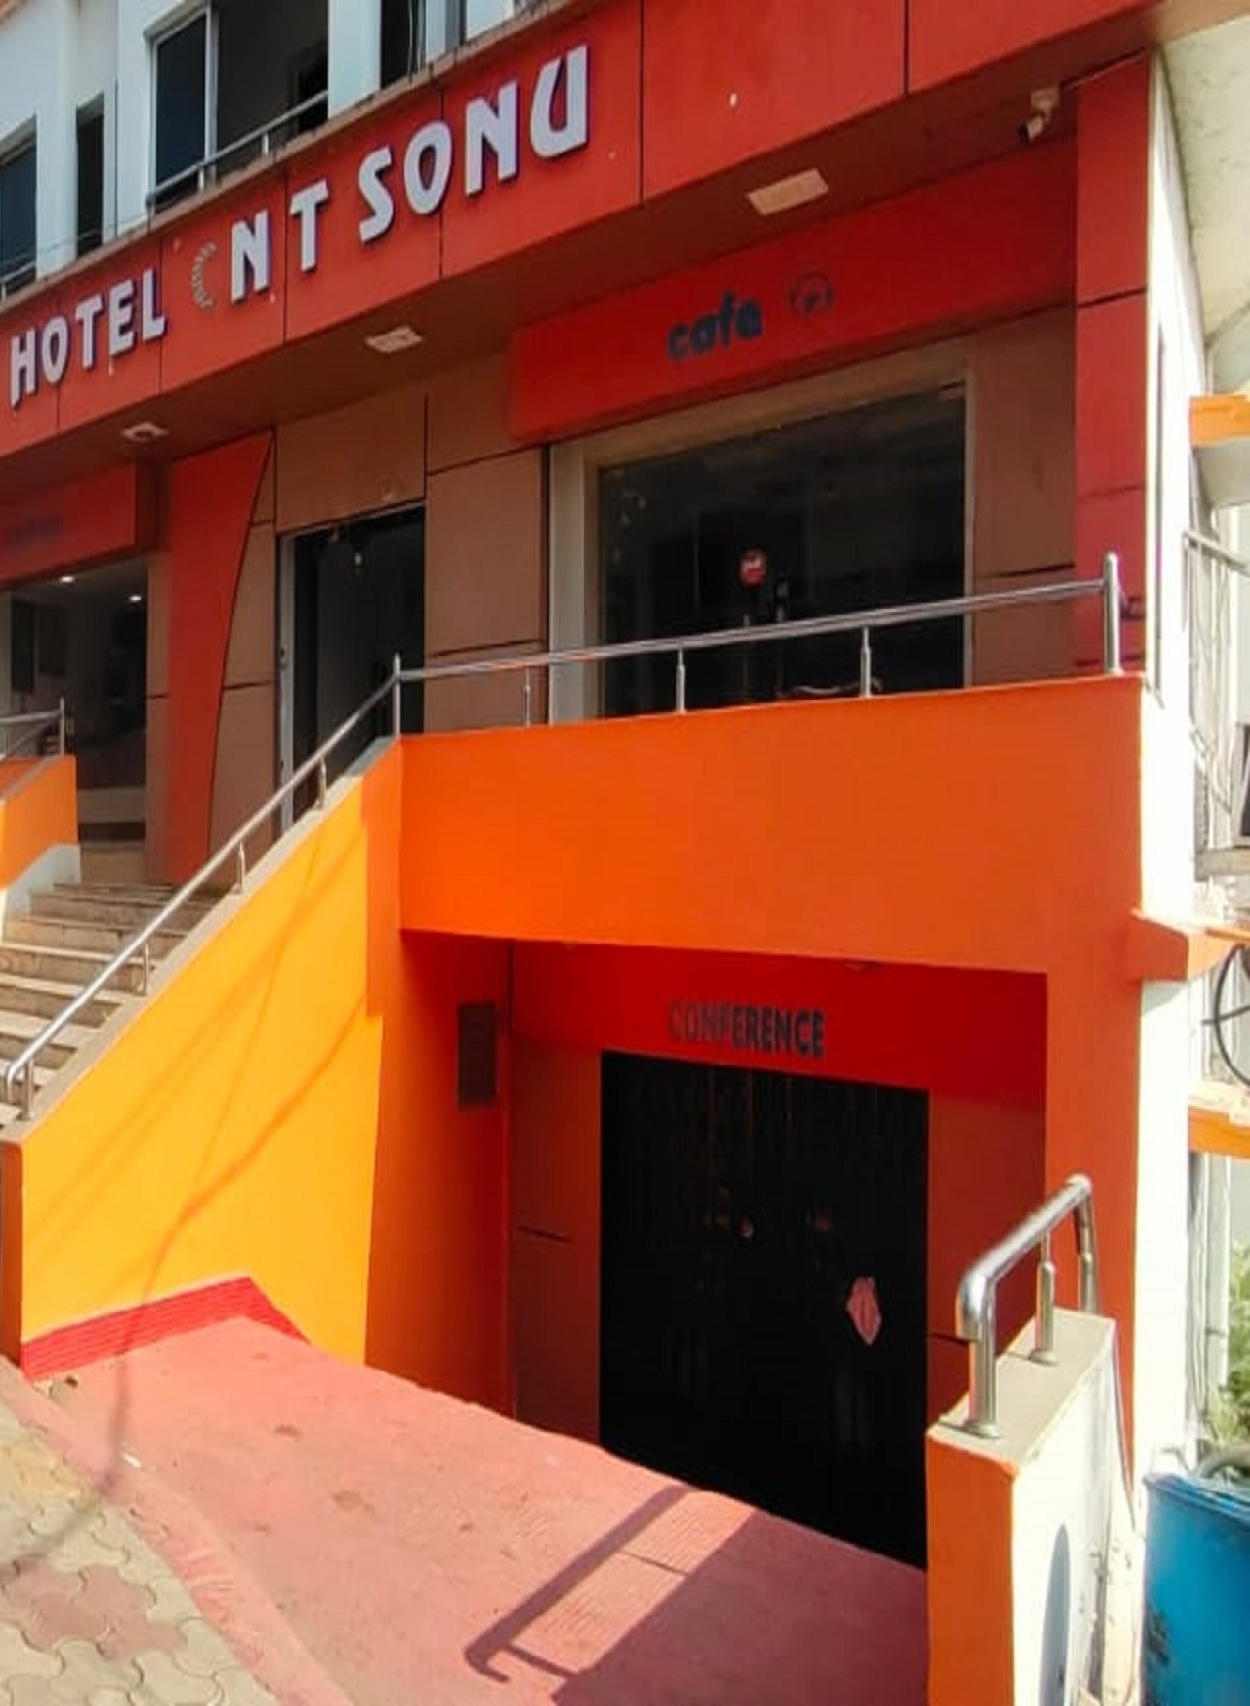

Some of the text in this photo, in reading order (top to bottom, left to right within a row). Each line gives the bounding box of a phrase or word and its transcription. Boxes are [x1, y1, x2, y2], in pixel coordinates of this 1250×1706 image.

[10, 267, 167, 407] HOTEL
[357, 45, 588, 244] SONU
[669, 1001, 825, 1059] CONFERENCE
